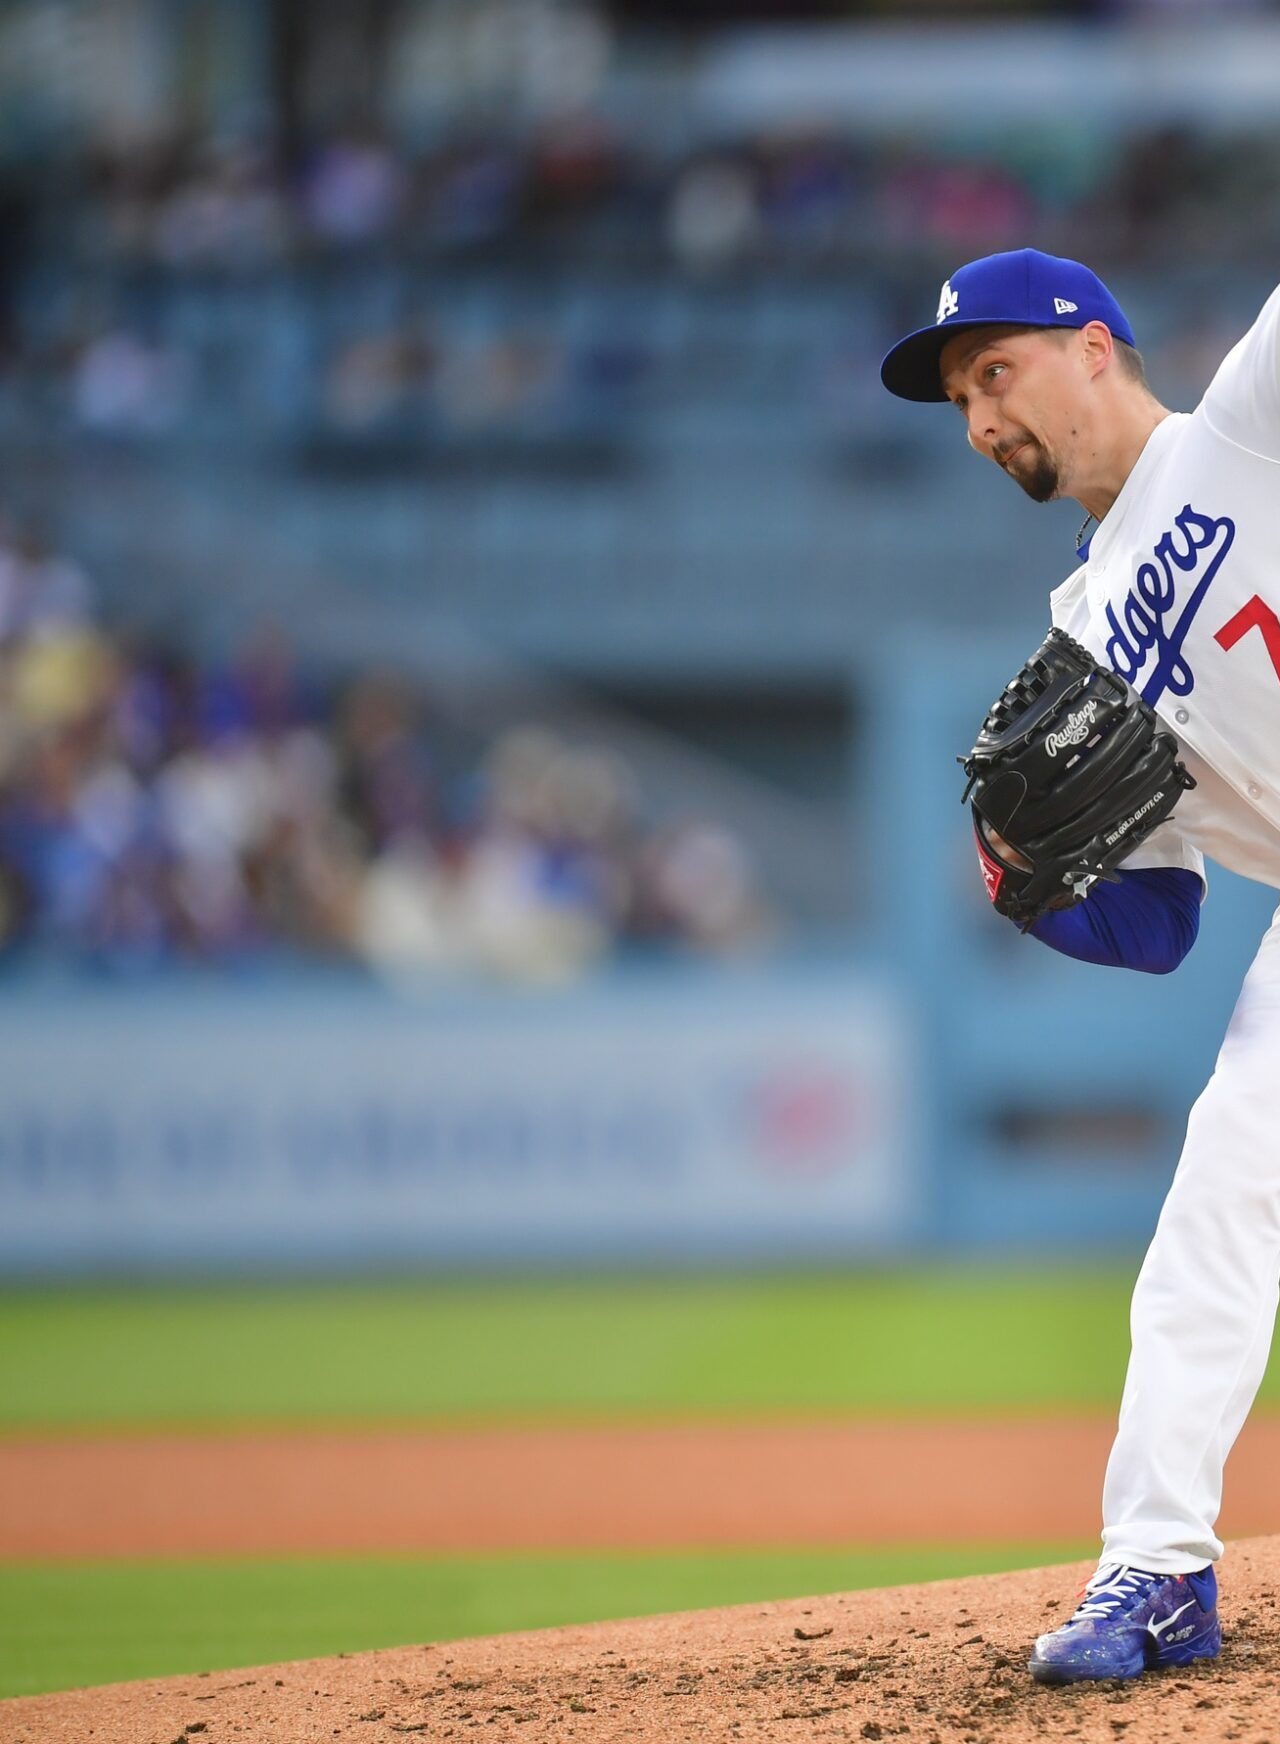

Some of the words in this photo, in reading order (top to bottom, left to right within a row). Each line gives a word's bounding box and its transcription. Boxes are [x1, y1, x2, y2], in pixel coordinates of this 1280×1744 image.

[1105, 504, 1236, 711] dgers
[1045, 699, 1098, 757] Rawlings
[1118, 816, 1136, 835] GOLD
[1133, 798, 1156, 820] GLOVE
